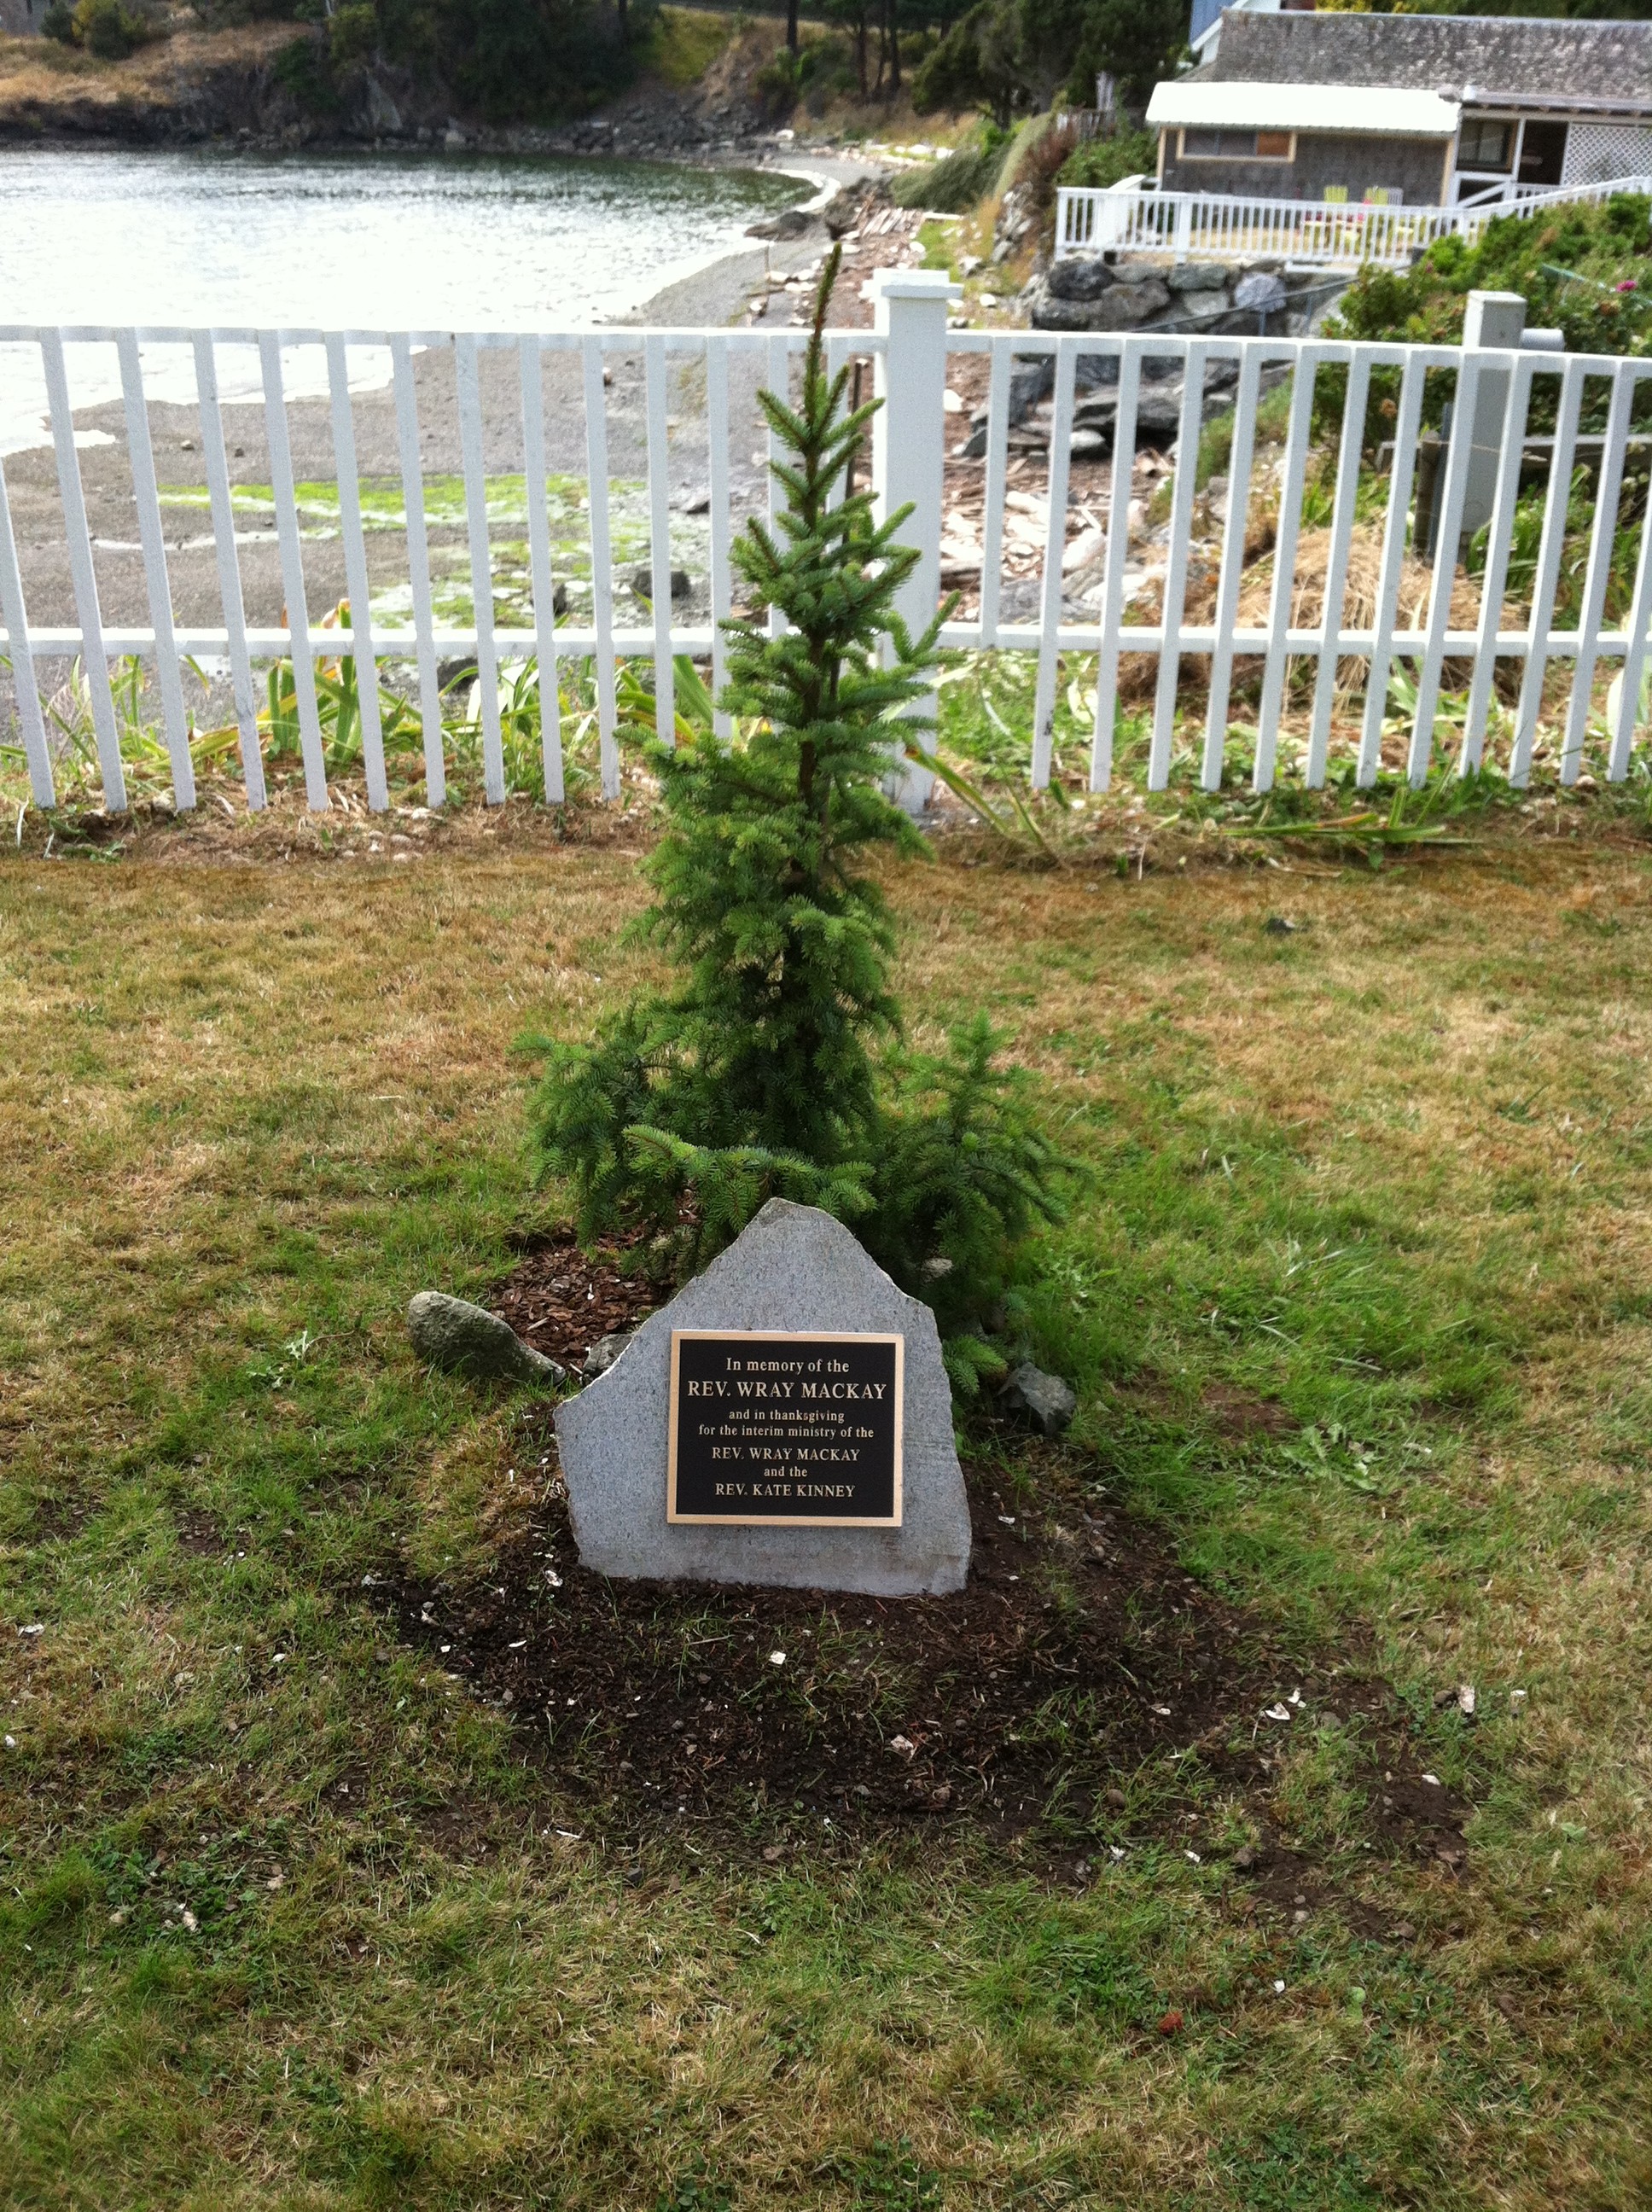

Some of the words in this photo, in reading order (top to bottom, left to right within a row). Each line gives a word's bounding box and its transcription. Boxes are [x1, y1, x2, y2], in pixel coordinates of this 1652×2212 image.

[726, 1357, 742, 1371] In
[747, 1361, 805, 1375] memory
[807, 1359, 823, 1372] of
[827, 1359, 850, 1373] the
[687, 1381, 731, 1398] REV.
[736, 1381, 795, 1399] WRAY
[800, 1382, 887, 1400] MACKAY
[728, 1409, 750, 1420] and
[754, 1409, 765, 1420] in
[769, 1410, 845, 1423] thanksgiving
[698, 1424, 716, 1435] for
[719, 1424, 738, 1436] the
[742, 1425, 784, 1437] interim
[788, 1426, 836, 1440] ministry
[840, 1426, 853, 1438] of
[855, 1427, 875, 1439] the
[711, 1447, 745, 1460] REV.
[748, 1447, 793, 1460] WRAY
[796, 1447, 861, 1461] MACKAY
[763, 1466, 785, 1477] and
[788, 1466, 808, 1477] the
[714, 1483, 748, 1496] REV.
[752, 1483, 793, 1497] KATE
[796, 1484, 856, 1498] KINNEY
